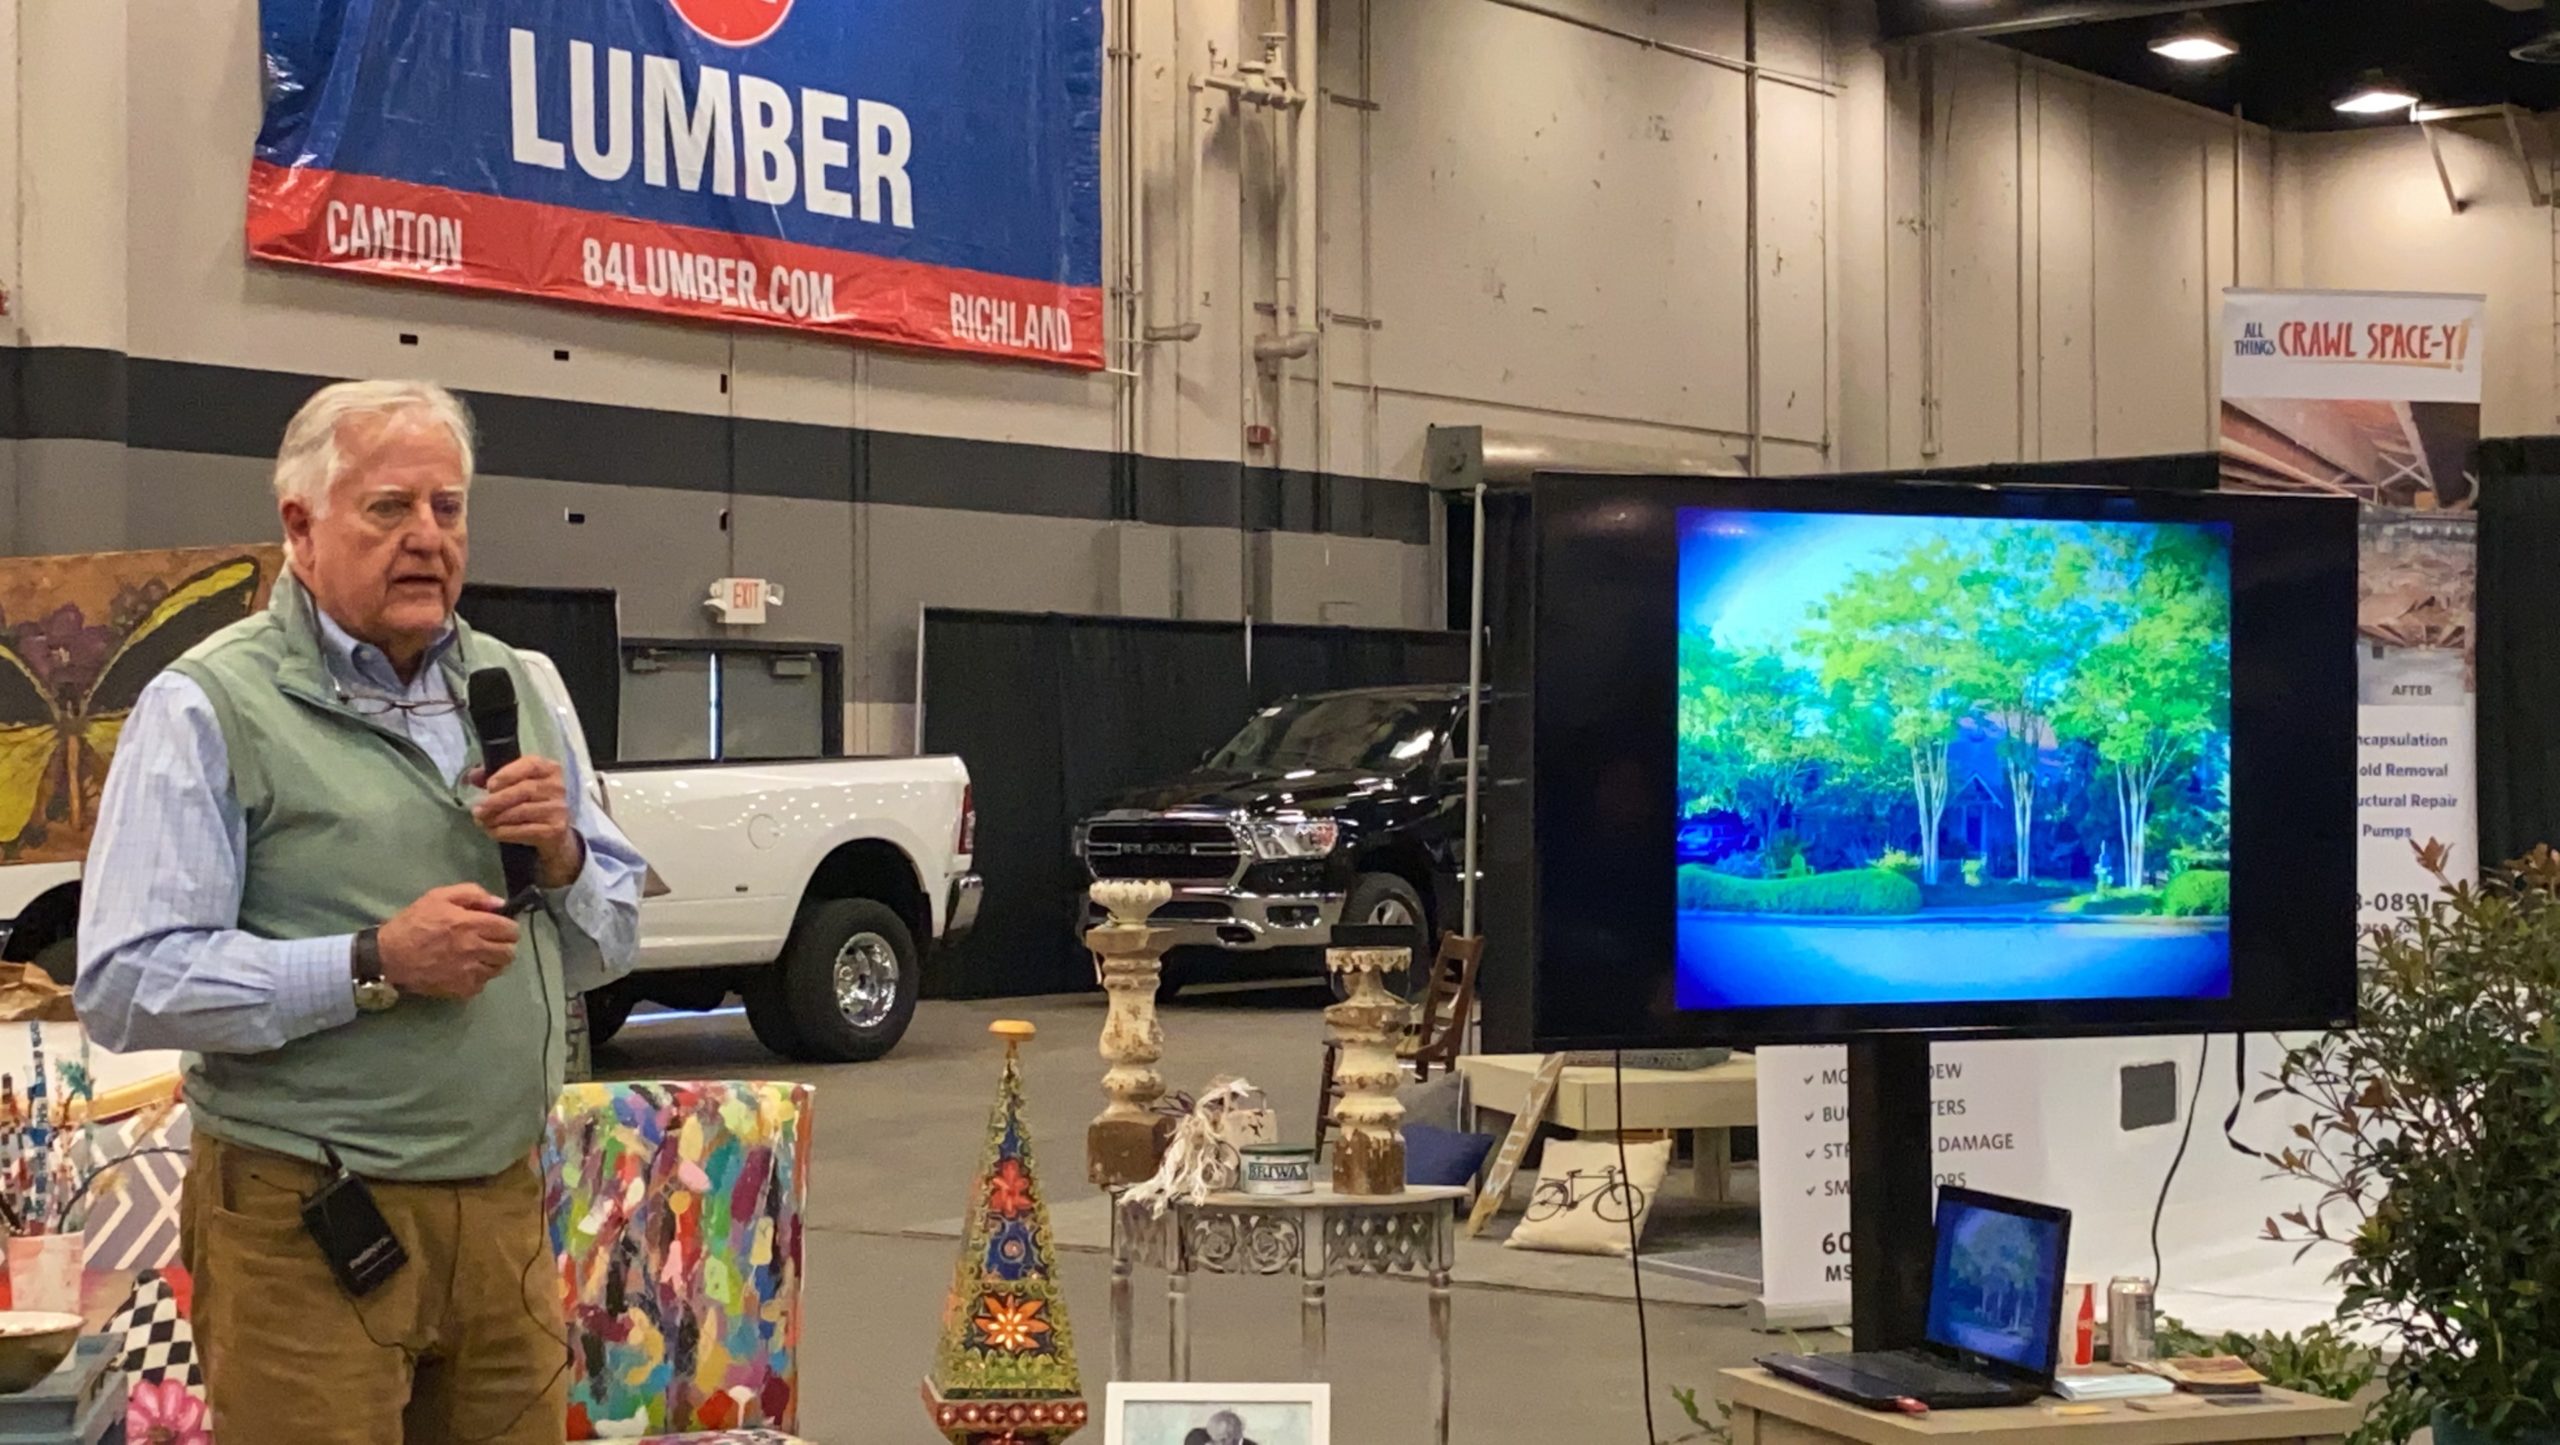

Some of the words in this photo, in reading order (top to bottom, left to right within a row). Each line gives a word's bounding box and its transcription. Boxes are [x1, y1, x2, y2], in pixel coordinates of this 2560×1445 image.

[509, 27, 914, 229] LUMBER
[326, 200, 463, 271] CANTON
[582, 237, 836, 322] 84LUMBER.COM
[950, 292, 1073, 352] RICHLAND
[2243, 322, 2264, 338] ALL
[2234, 339, 2276, 356] THINGS
[2279, 321, 2356, 357] CRAWL
[733, 582, 759, 608] EXIT
[2391, 685, 2432, 696] AFTER
[2357, 732, 2448, 748] ncapsulation
[2359, 763, 2382, 776] old
[2386, 763, 2448, 776] Removal
[2357, 794, 2407, 807] uctural
[2410, 794, 2458, 810] Repair
[2363, 824, 2412, 839] Pumps
[1938, 1133, 2014, 1152] DAMAGE
